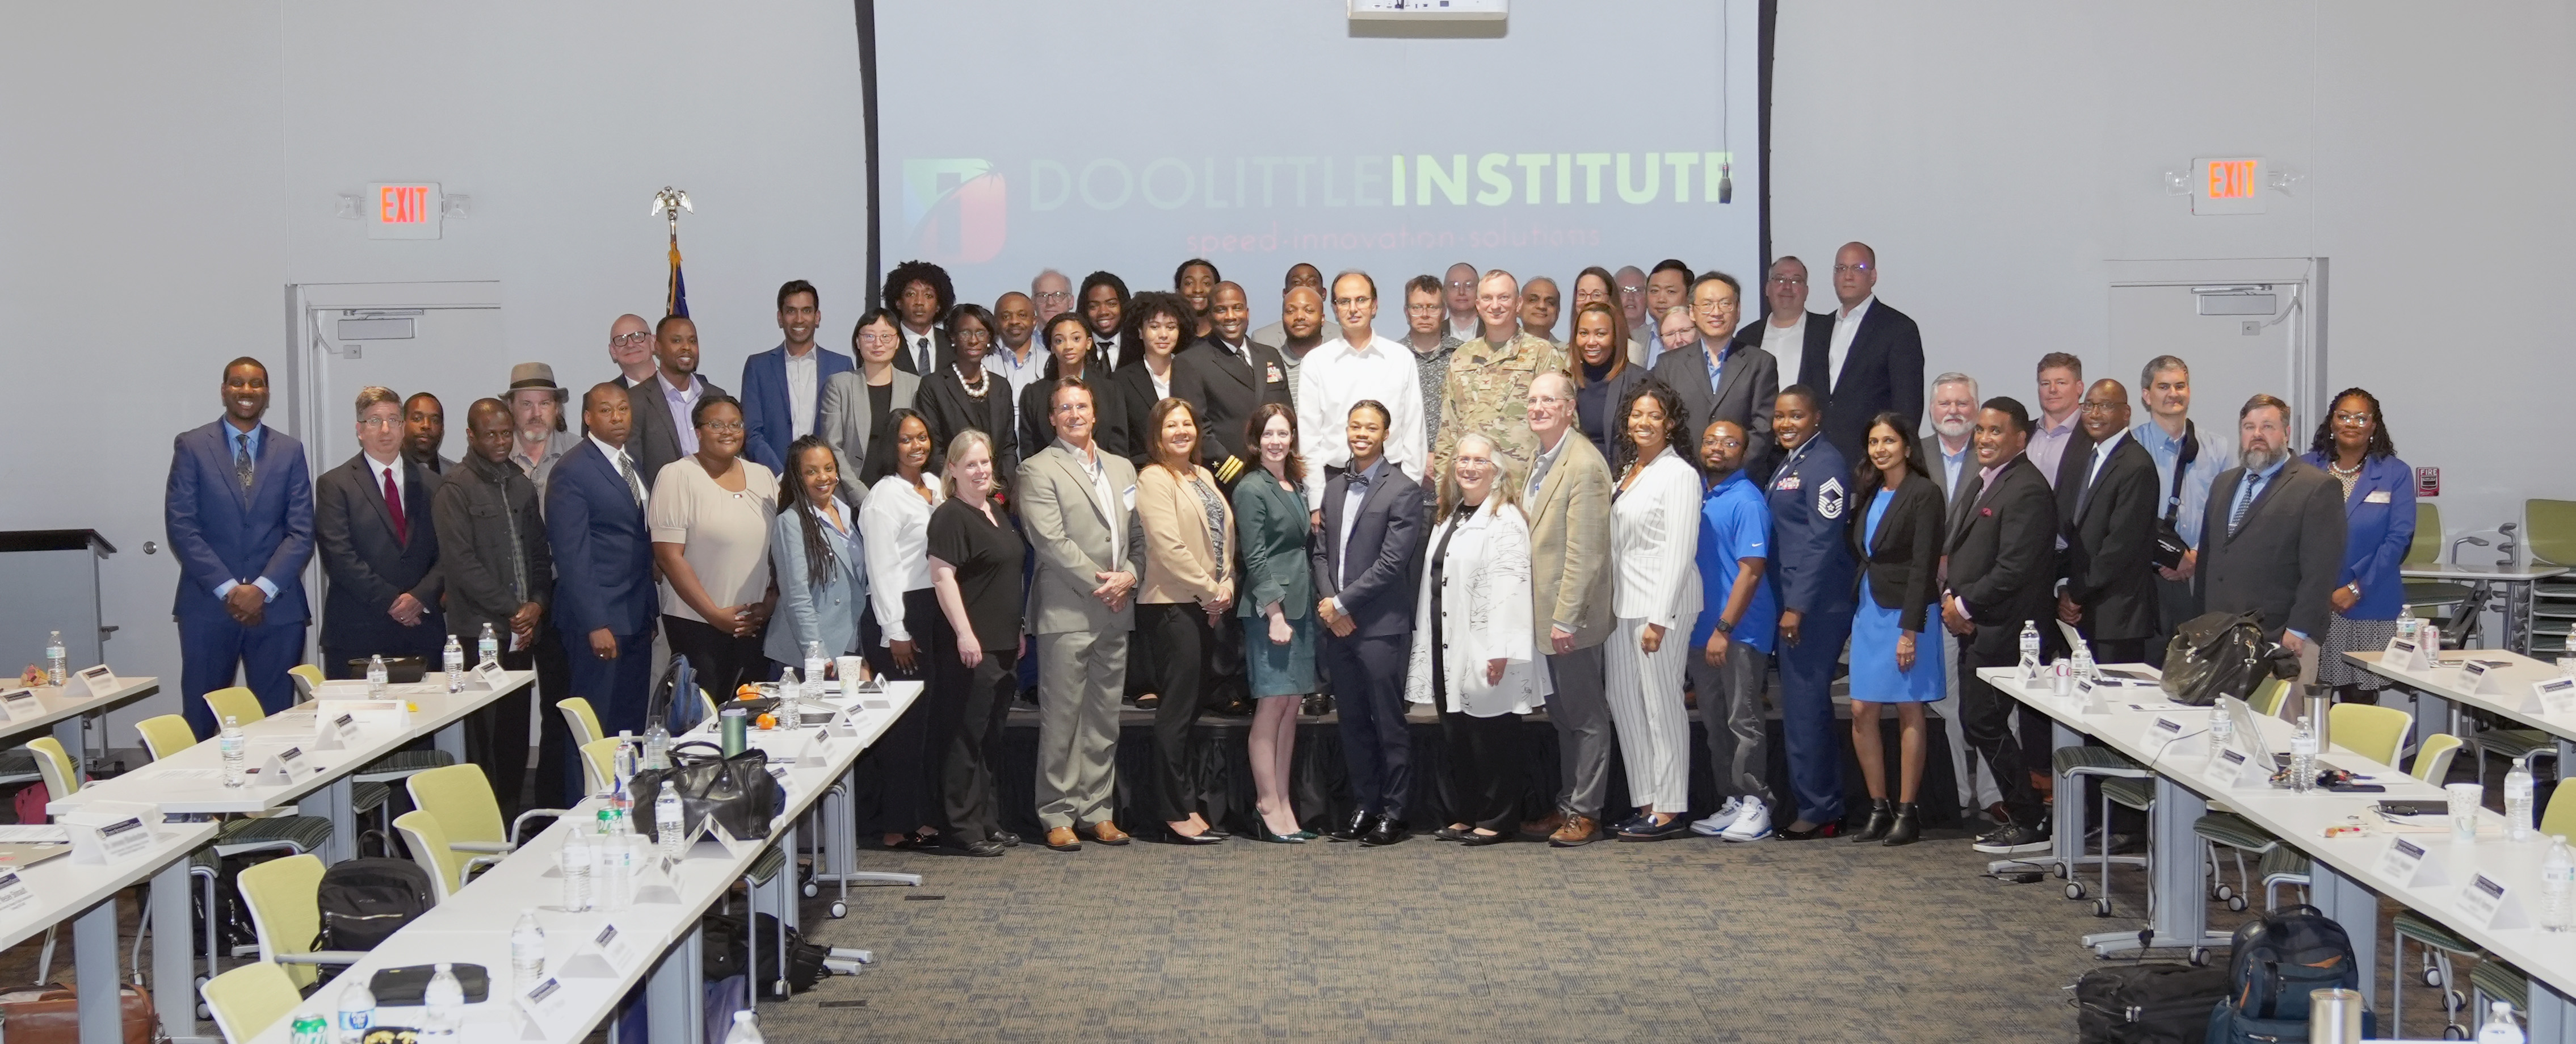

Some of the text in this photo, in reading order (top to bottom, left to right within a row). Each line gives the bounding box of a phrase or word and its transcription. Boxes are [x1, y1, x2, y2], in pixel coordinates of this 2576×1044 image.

[2208, 160, 2257, 199] EXIT
[380, 186, 428, 223] EXIT
[2056, 664, 2072, 677] Co
